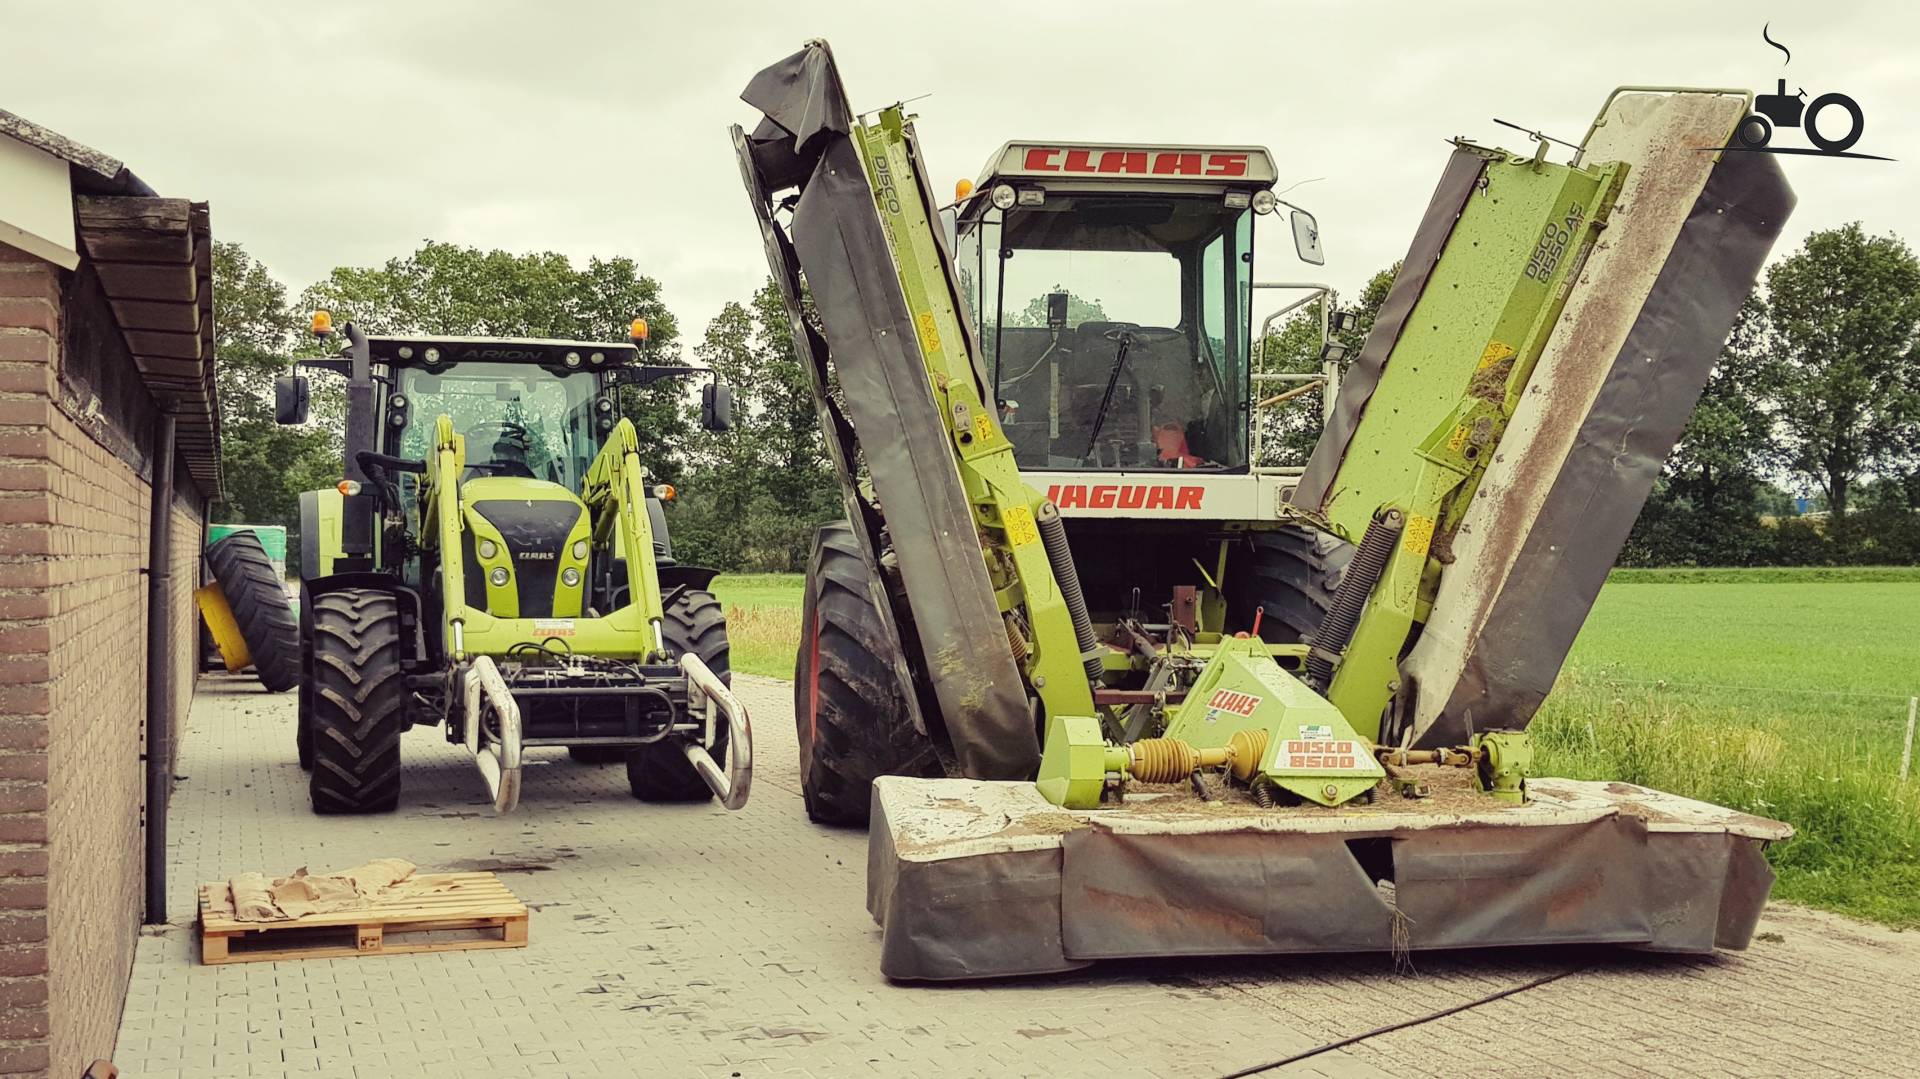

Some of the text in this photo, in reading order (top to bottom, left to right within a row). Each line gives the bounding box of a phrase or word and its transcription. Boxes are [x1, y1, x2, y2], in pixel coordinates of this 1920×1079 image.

[1024, 148, 1248, 176] CLAAS
[875, 155, 900, 214] DISCO
[1525, 222, 1559, 280] DISCO
[463, 350, 543, 359] ARION
[1047, 485, 1205, 510] JAGUAR
[519, 552, 555, 560] CLAAS
[1209, 690, 1260, 716] CLAAS
[1288, 741, 1352, 754] DISCO
[1290, 755, 1355, 769] 8500
